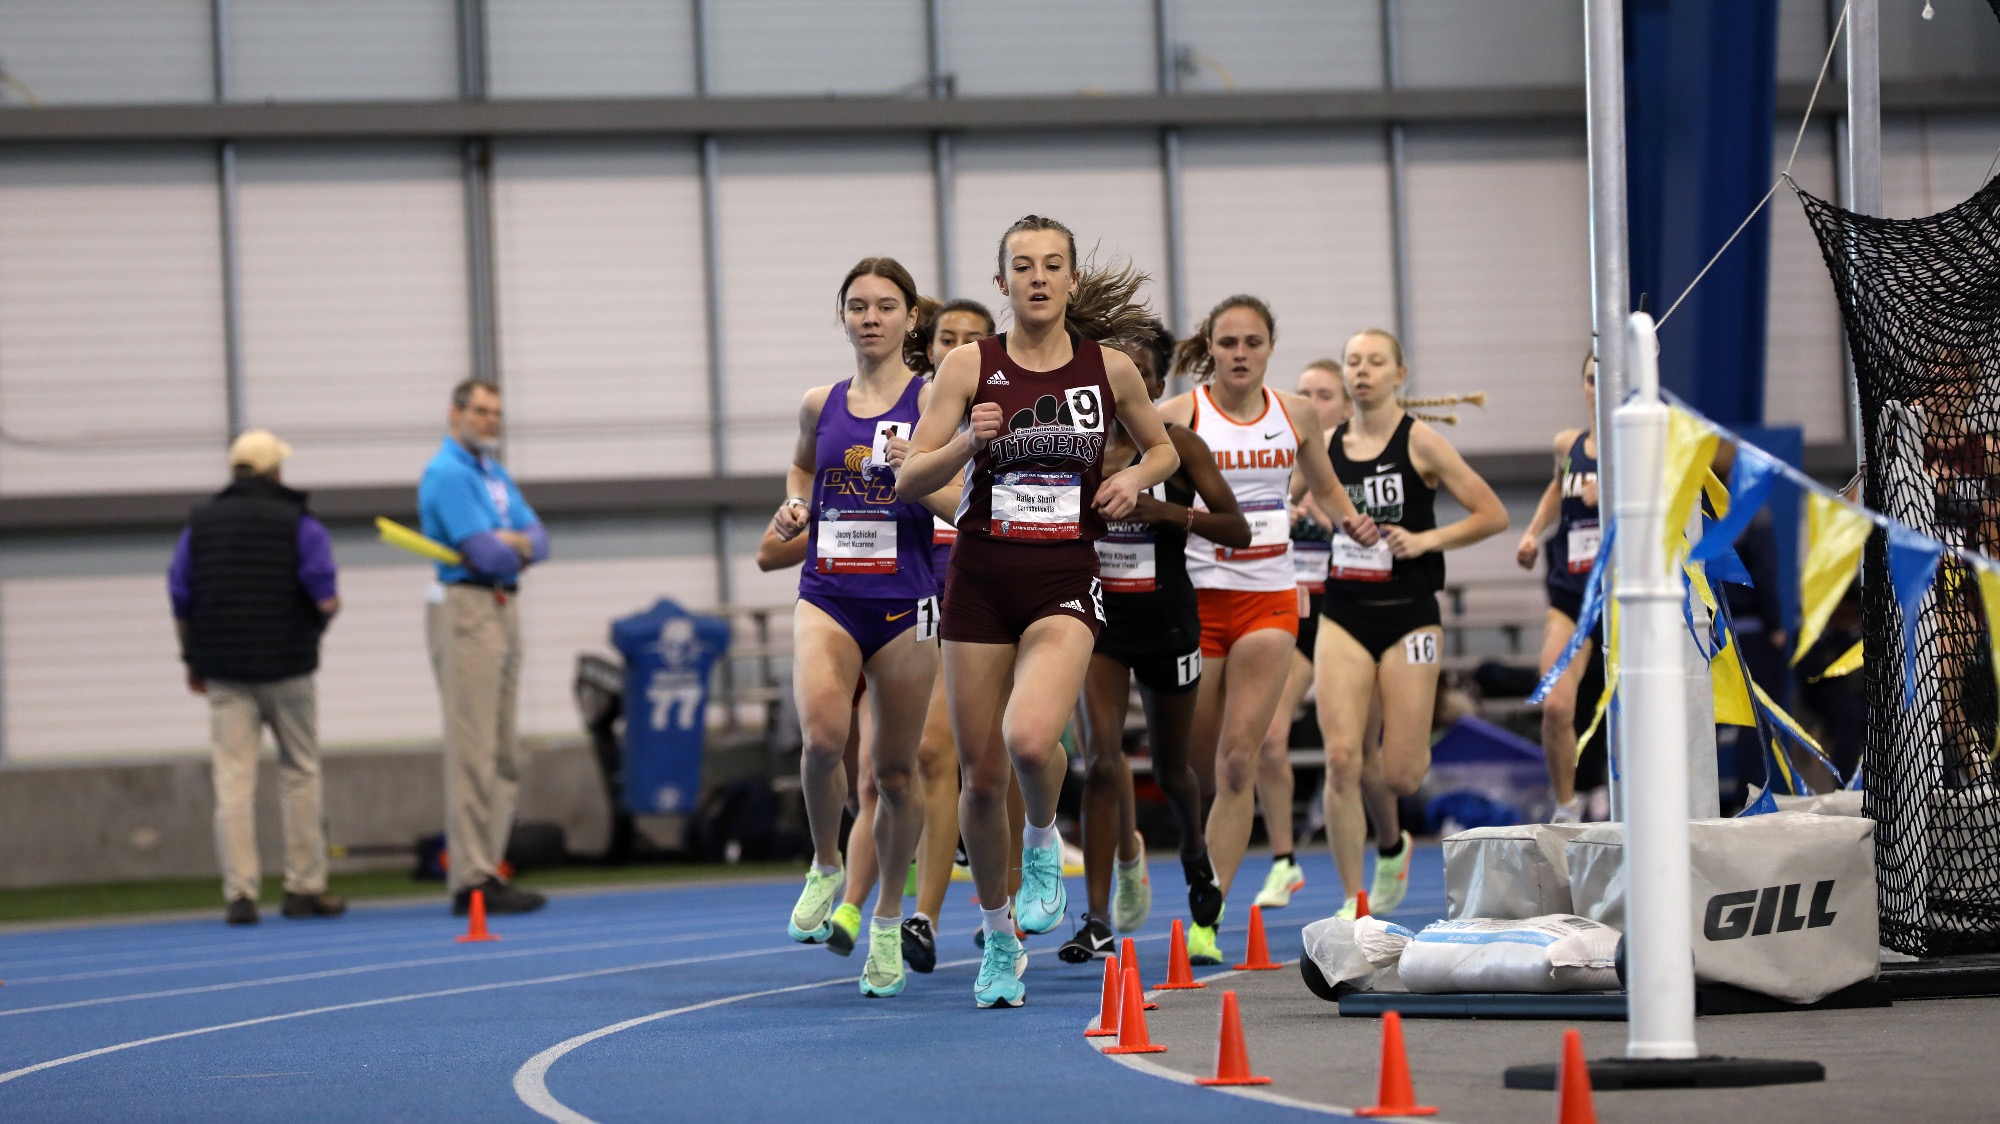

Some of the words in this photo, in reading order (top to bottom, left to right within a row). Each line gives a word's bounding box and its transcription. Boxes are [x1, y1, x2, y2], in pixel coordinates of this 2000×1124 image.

[1073, 390, 1100, 429] 9
[990, 432, 1103, 466] TIGERS
[1211, 448, 1295, 470] ILLIGAN
[824, 468, 898, 504] ONU
[1016, 494, 1035, 504] Hailey
[1368, 477, 1398, 506] 16
[835, 531, 851, 540] Jacey
[852, 530, 877, 539] Schickel
[922, 597, 933, 637] 1
[1408, 635, 1435, 663] 16
[1181, 652, 1200, 682] 11
[646, 686, 702, 731] 77
[1704, 880, 1837, 941] GILL
